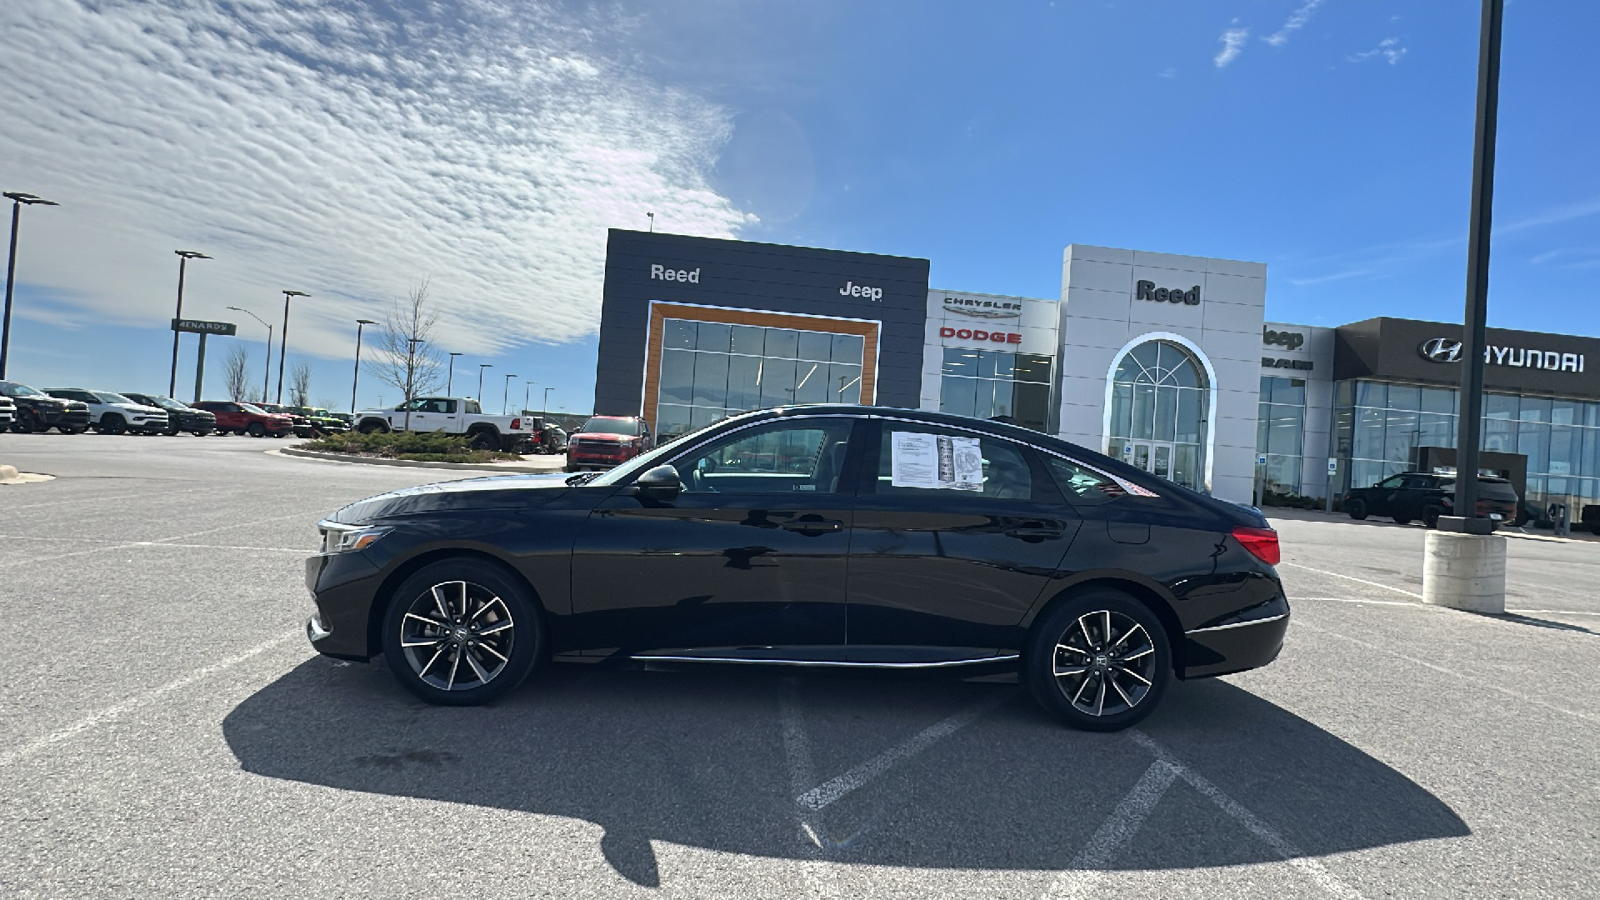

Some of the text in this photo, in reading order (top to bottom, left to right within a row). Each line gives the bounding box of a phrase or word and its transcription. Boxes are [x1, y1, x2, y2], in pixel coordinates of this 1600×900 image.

[651, 264, 701, 284] Reed
[840, 281, 883, 302] Jeep
[1137, 279, 1201, 305] Reed
[944, 297, 1021, 310] CHRYSLER
[940, 326, 1022, 343] DODGE
